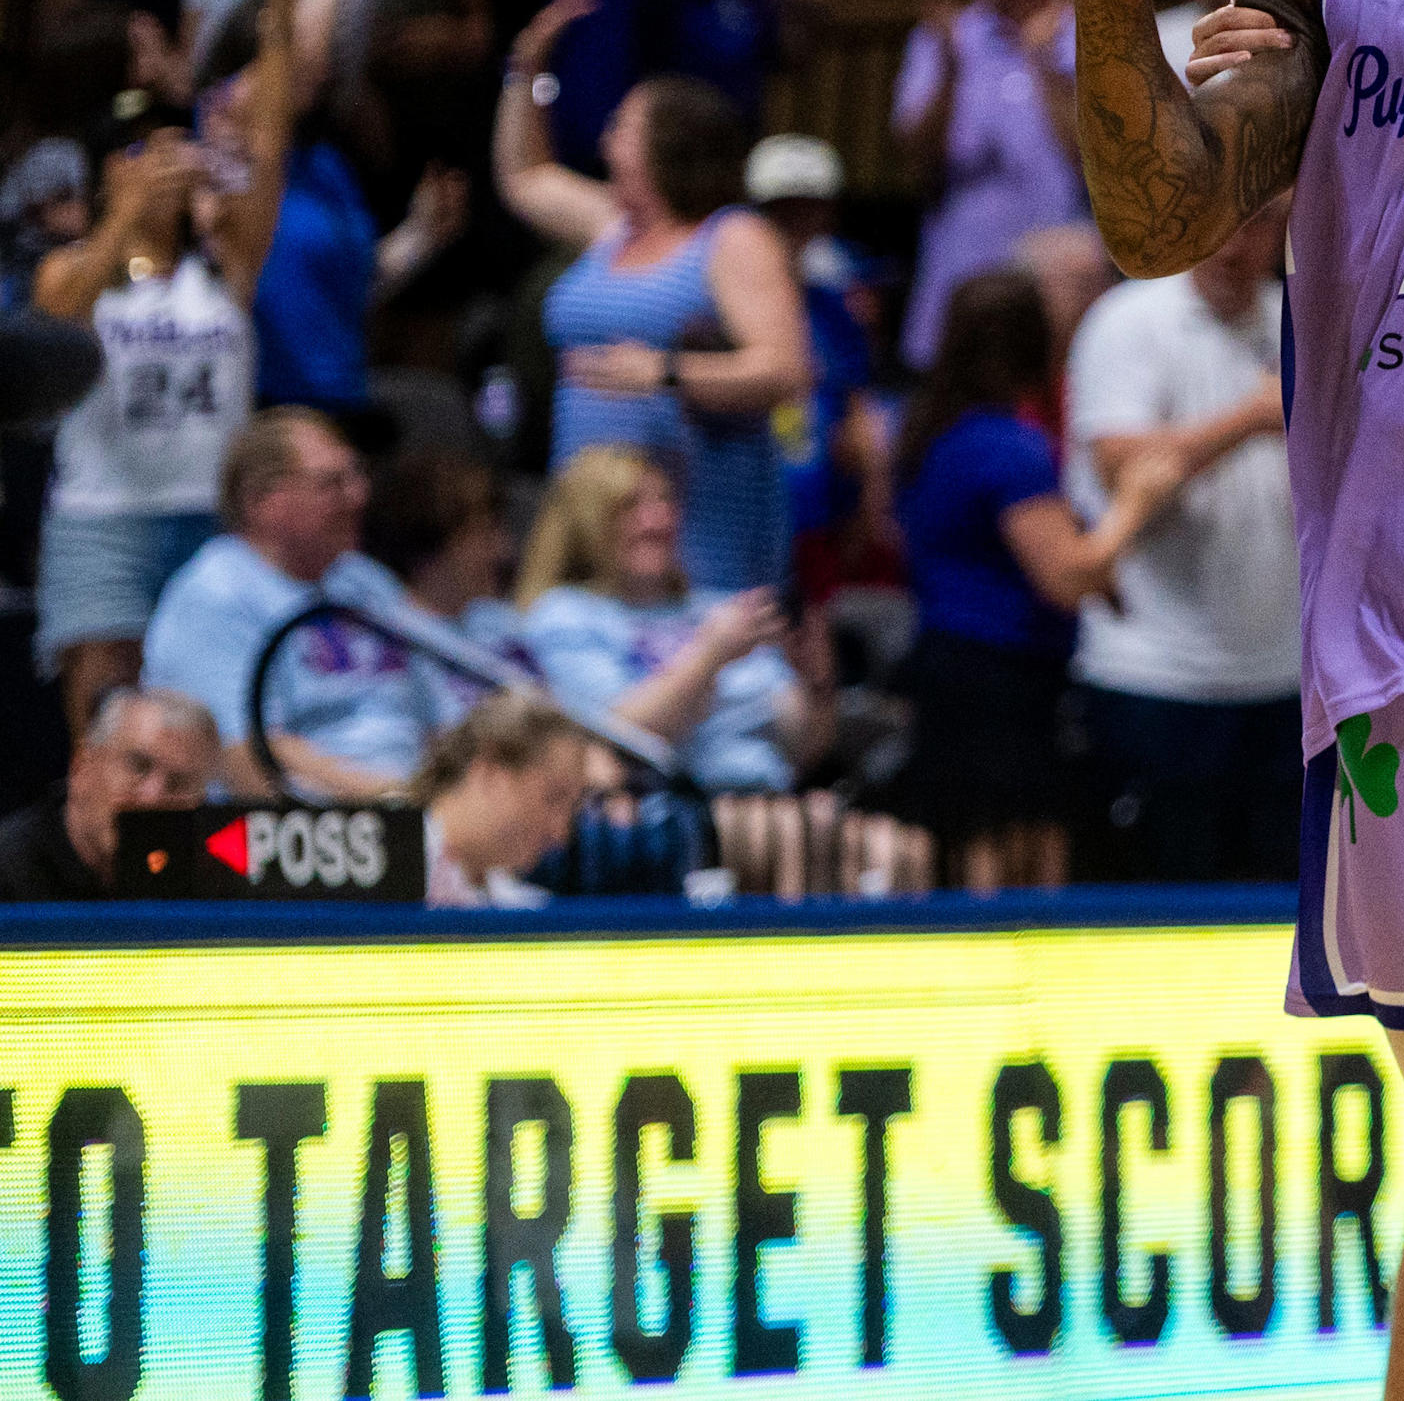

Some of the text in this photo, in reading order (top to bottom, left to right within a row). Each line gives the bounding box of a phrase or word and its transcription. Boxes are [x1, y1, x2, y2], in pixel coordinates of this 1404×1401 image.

[245, 809, 388, 889] POSS
[0, 1086, 147, 1401] O
[234, 1066, 914, 1401] TARGET
[990, 1052, 1394, 1357] SCOR
